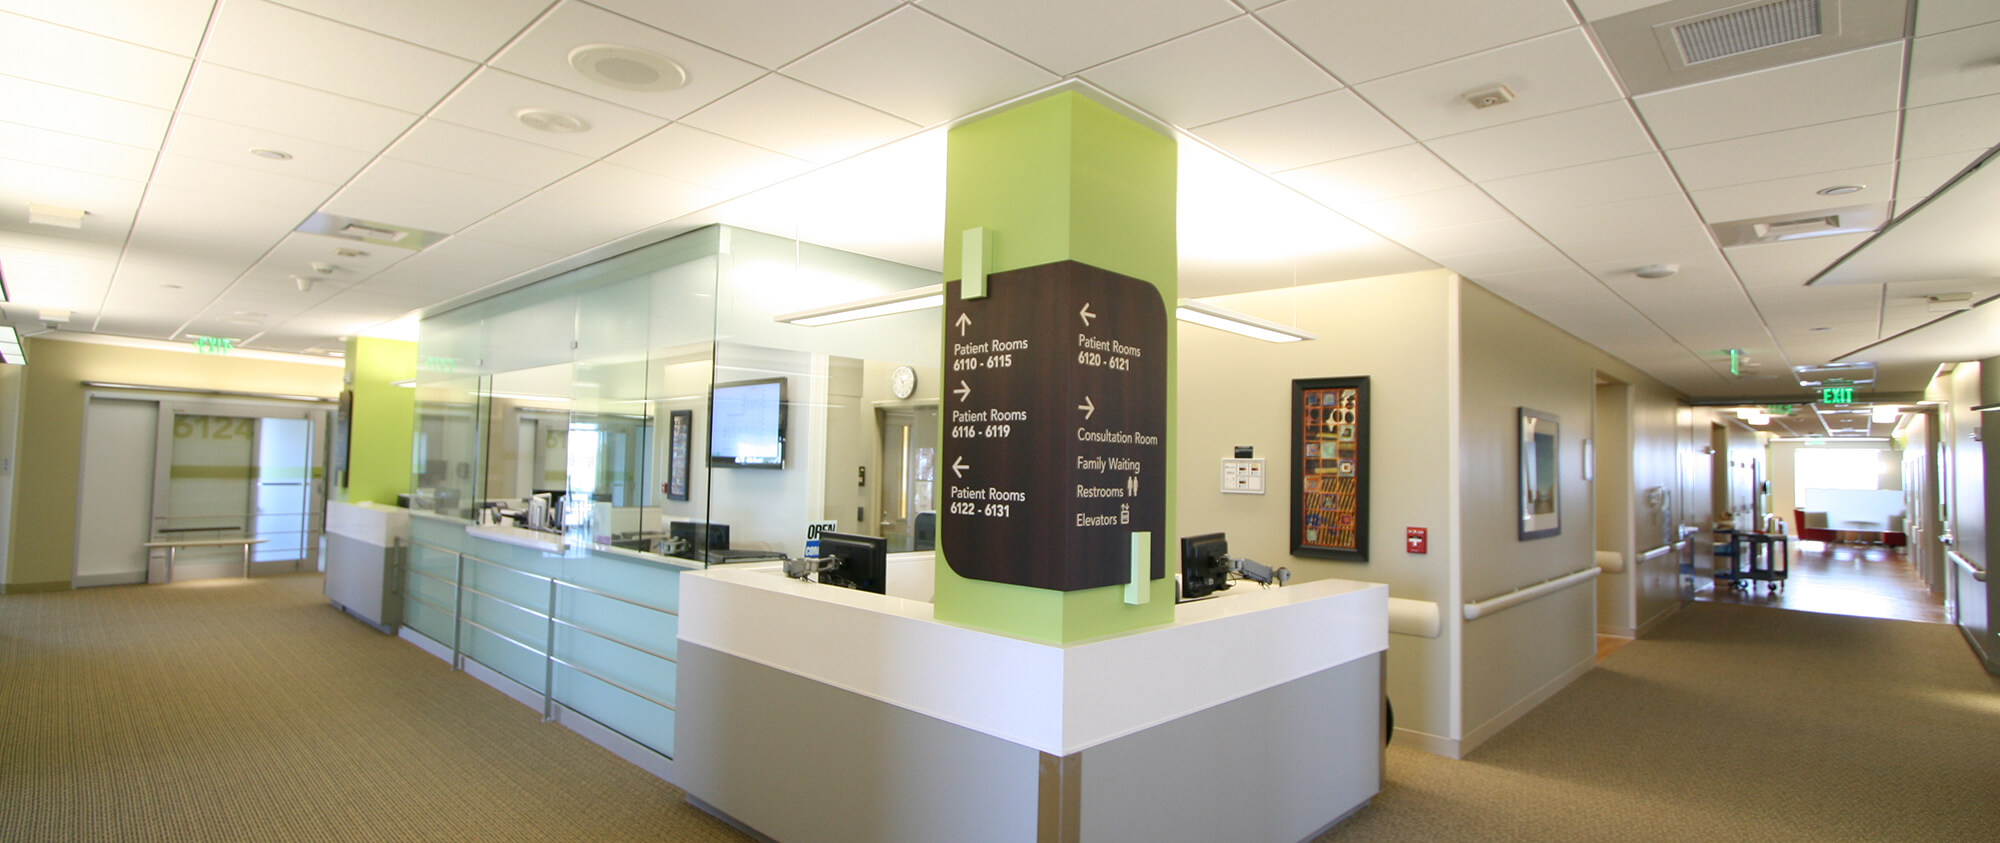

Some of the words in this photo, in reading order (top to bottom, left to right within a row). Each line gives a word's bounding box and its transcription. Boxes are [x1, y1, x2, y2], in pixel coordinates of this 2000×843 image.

[198, 336, 231, 356] EXIT
[954, 343, 989, 356] Patient
[992, 339, 1028, 352] Rooms
[1079, 333, 1110, 352] Patient
[1112, 340, 1142, 357] Rooms
[953, 357, 978, 371] 6110
[986, 354, 1013, 369] 6115
[1078, 350, 1102, 367] 6120
[1109, 355, 1130, 371] 6121
[1822, 387, 1854, 404] EXIT
[952, 409, 988, 422] Patient
[990, 408, 1028, 421] Rooms
[173, 414, 253, 440] 6124
[951, 425, 976, 438] 6116
[985, 424, 1011, 438] 6119
[1077, 427, 1133, 444] Consultation
[1134, 431, 1158, 445] Room
[1077, 456, 1107, 474] Family
[1108, 457, 1141, 474] Waiting
[951, 485, 986, 500] Patient
[989, 487, 1026, 502] Rooms
[1076, 484, 1124, 498] Restrooms
[950, 501, 975, 516] 6122
[984, 503, 1010, 518] 6131
[1076, 512, 1118, 527] Elevators
